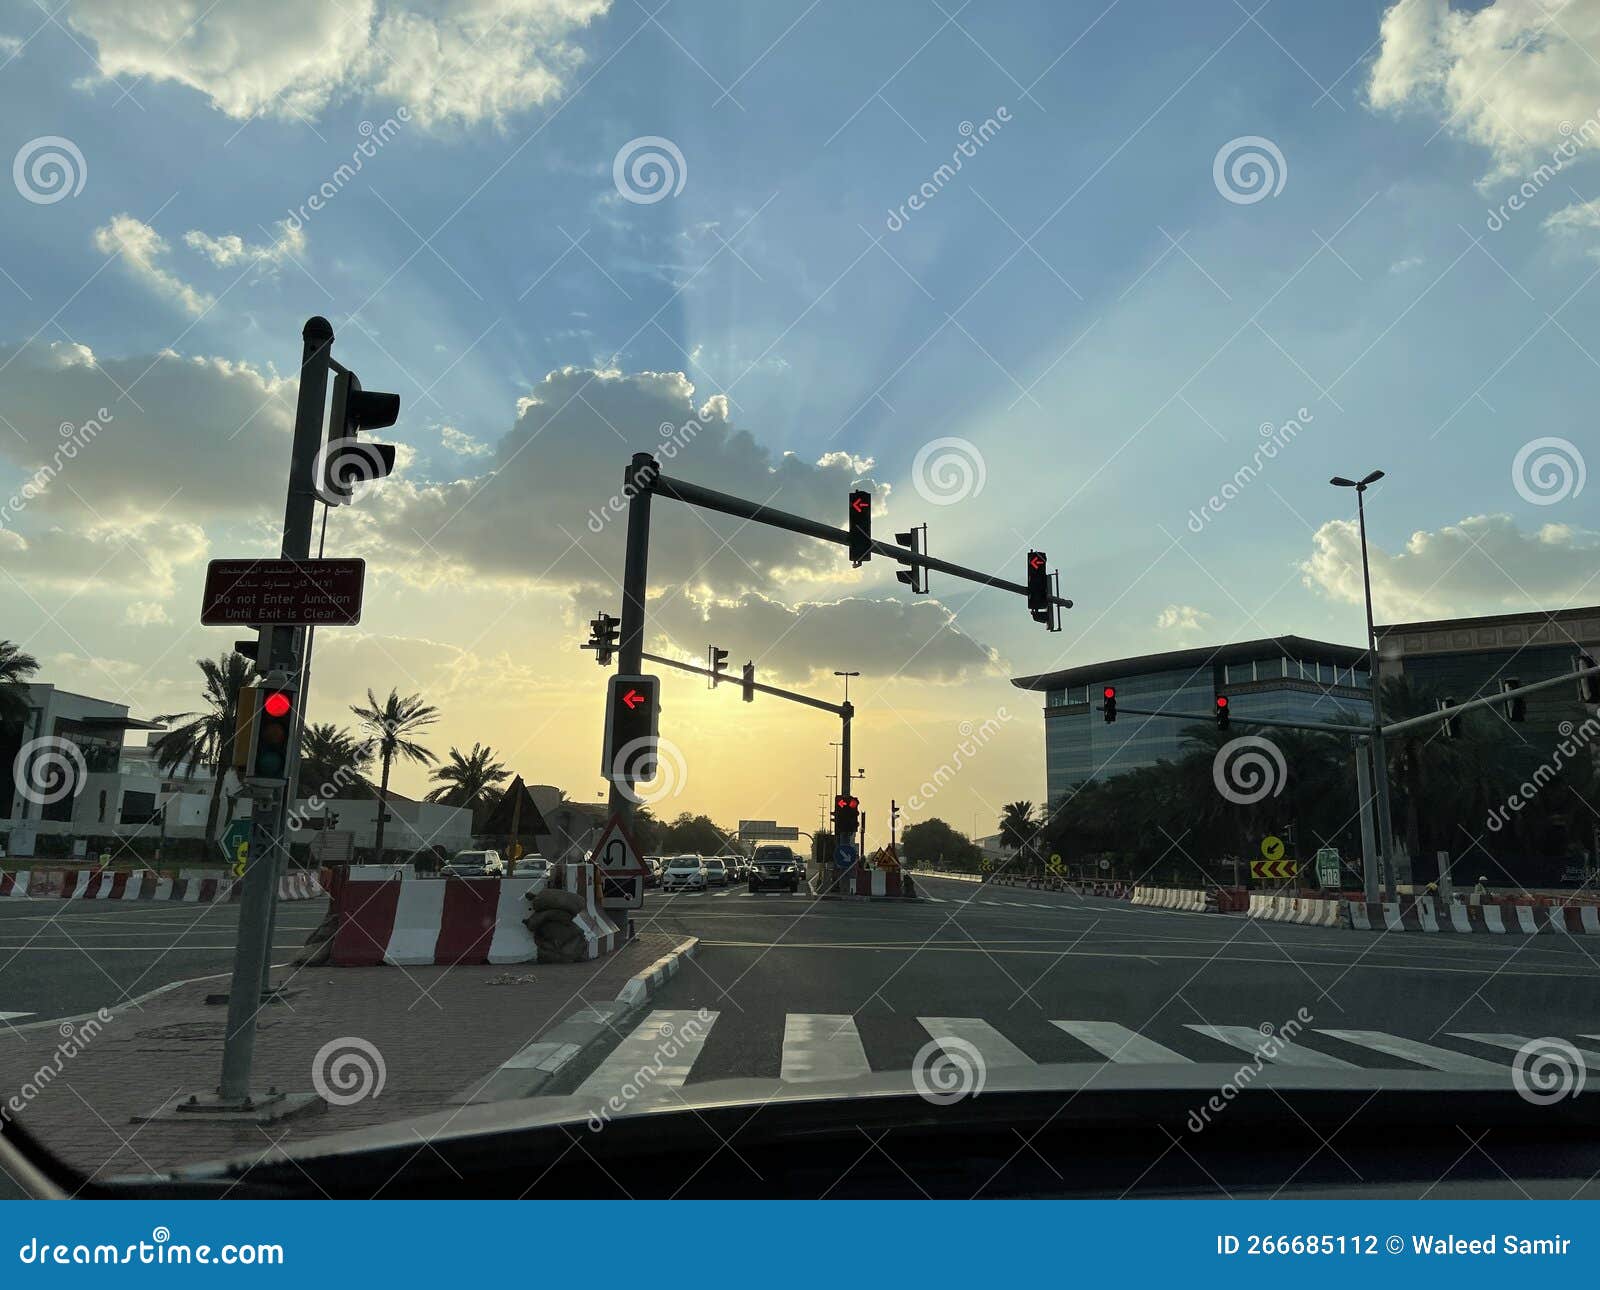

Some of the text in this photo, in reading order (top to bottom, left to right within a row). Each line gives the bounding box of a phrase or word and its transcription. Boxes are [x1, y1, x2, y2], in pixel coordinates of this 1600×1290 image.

[236, 593, 257, 605] not
[263, 593, 295, 605] Enter
[301, 593, 352, 605] Junction
[225, 607, 252, 620] Until
[258, 607, 281, 620] Exit
[303, 607, 336, 620] Clear
